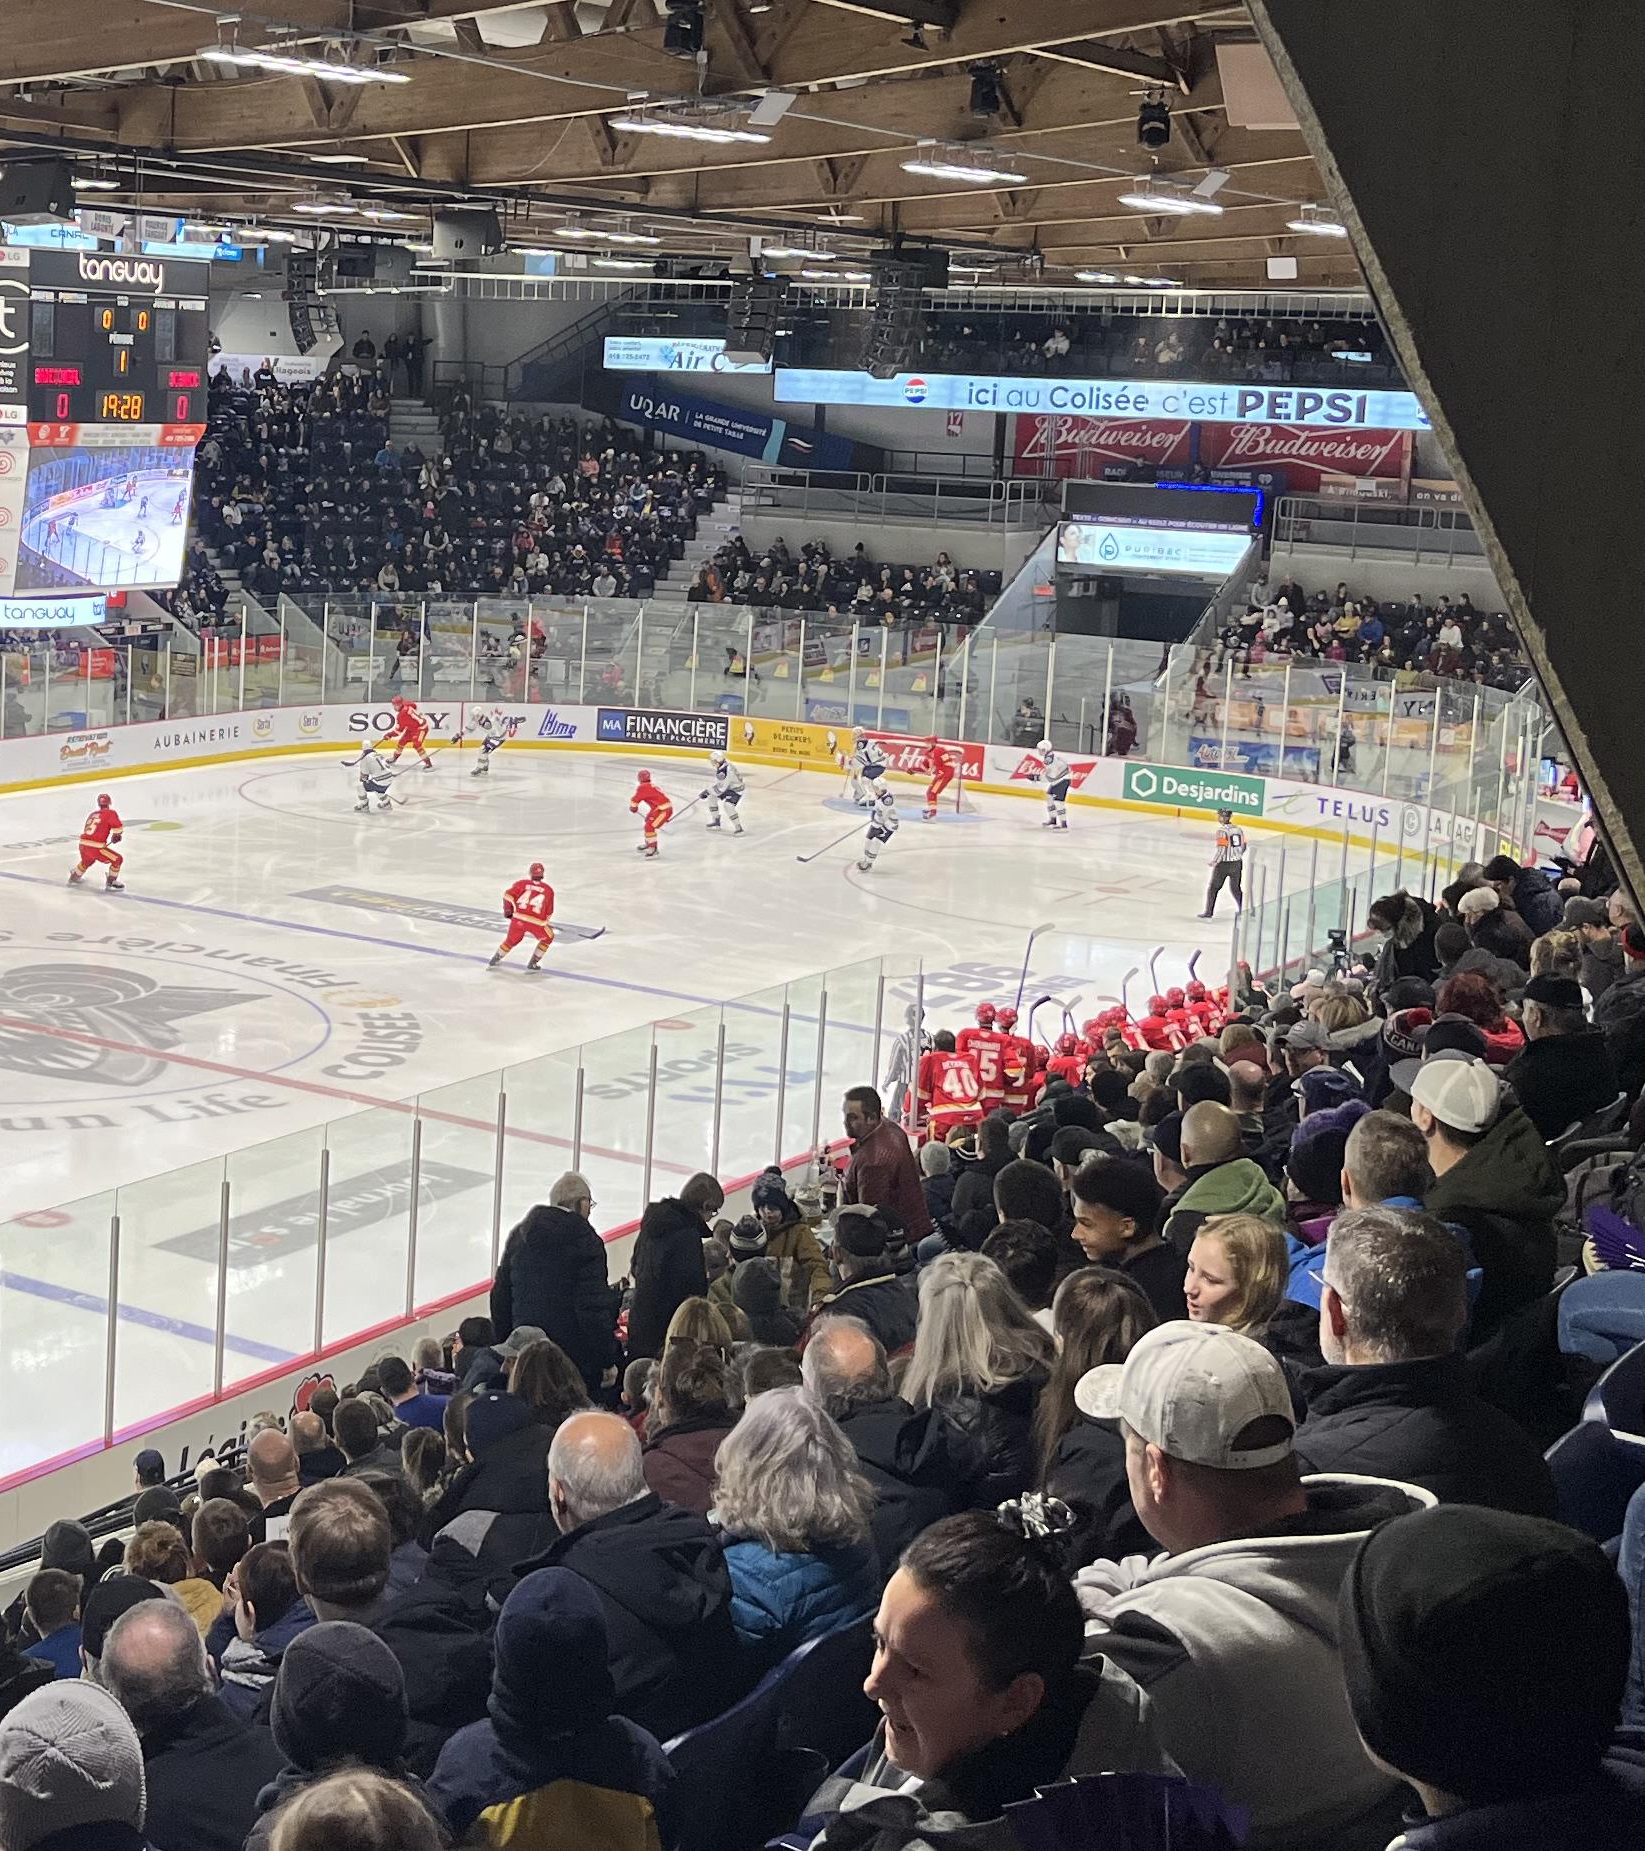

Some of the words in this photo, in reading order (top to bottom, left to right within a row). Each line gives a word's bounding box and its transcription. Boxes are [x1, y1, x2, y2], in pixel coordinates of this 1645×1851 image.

[79, 252, 164, 294] tanguay
[102, 308, 113, 330] 0
[138, 310, 150, 331] 0
[56, 392, 69, 419] 0
[102, 393, 142, 420] 19:28
[176, 395, 189, 420] 0
[629, 393, 681, 422] UQAR
[967, 381, 998, 406] ici
[1006, 388, 1040, 407] au
[1049, 385, 1149, 412] Colisée
[1162, 389, 1229, 415] c'est
[1237, 389, 1368, 424] PEPSI
[1230, 422, 1391, 462] Budweiser
[4, 603, 75, 624] tanguay
[349, 711, 450, 732] SOY
[602, 718, 622, 732] MA
[626, 715, 726, 740] FINANCIÈRE
[154, 726, 240, 750] AUBAINERIE
[1162, 776, 1260, 807] Desjardins
[1317, 797, 1390, 827] TELUS
[516, 890, 546, 914] 44
[942, 1068, 980, 1100] 40
[128, 1088, 290, 1131] Life
